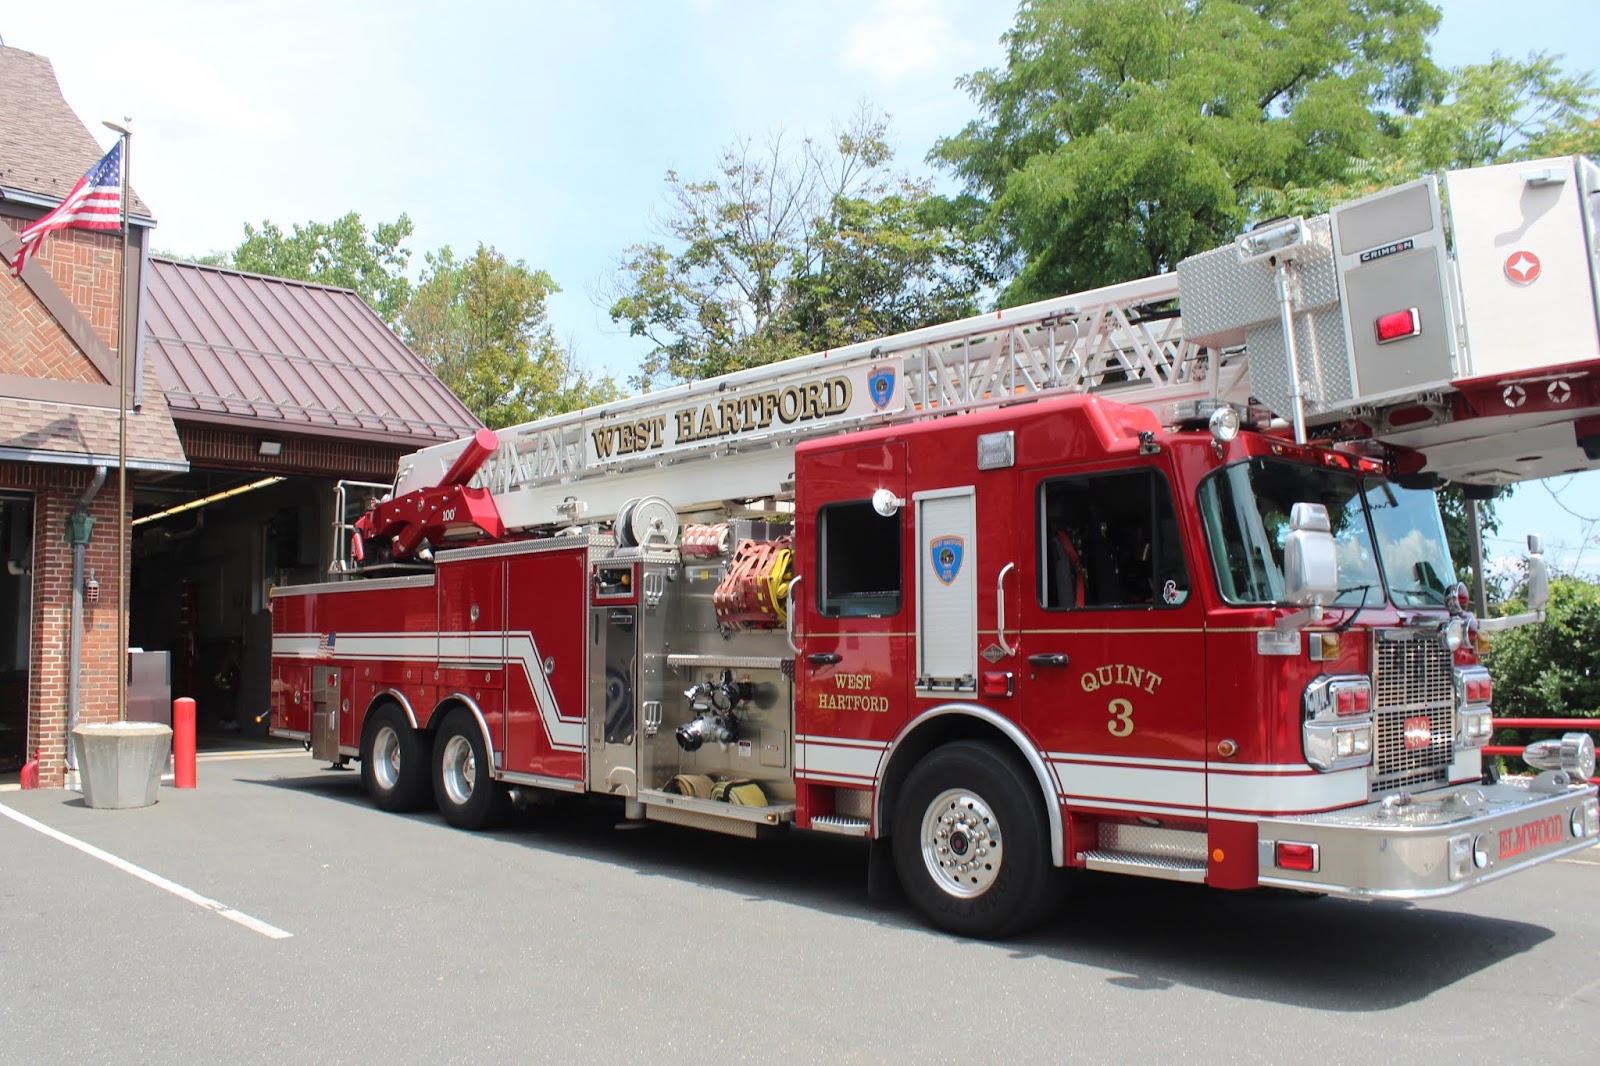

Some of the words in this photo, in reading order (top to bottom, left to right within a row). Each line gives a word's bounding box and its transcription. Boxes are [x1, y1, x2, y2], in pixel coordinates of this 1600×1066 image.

[1361, 240, 1412, 261] CRIMSON
[592, 414, 666, 459] WEST
[674, 375, 853, 444] HARTFORD
[834, 673, 872, 690] WEST
[1080, 664, 1162, 695] QUINT
[818, 693, 889, 712] HARTFORD
[1107, 698, 1134, 737] 3
[1498, 813, 1563, 859] ELMWOOD
